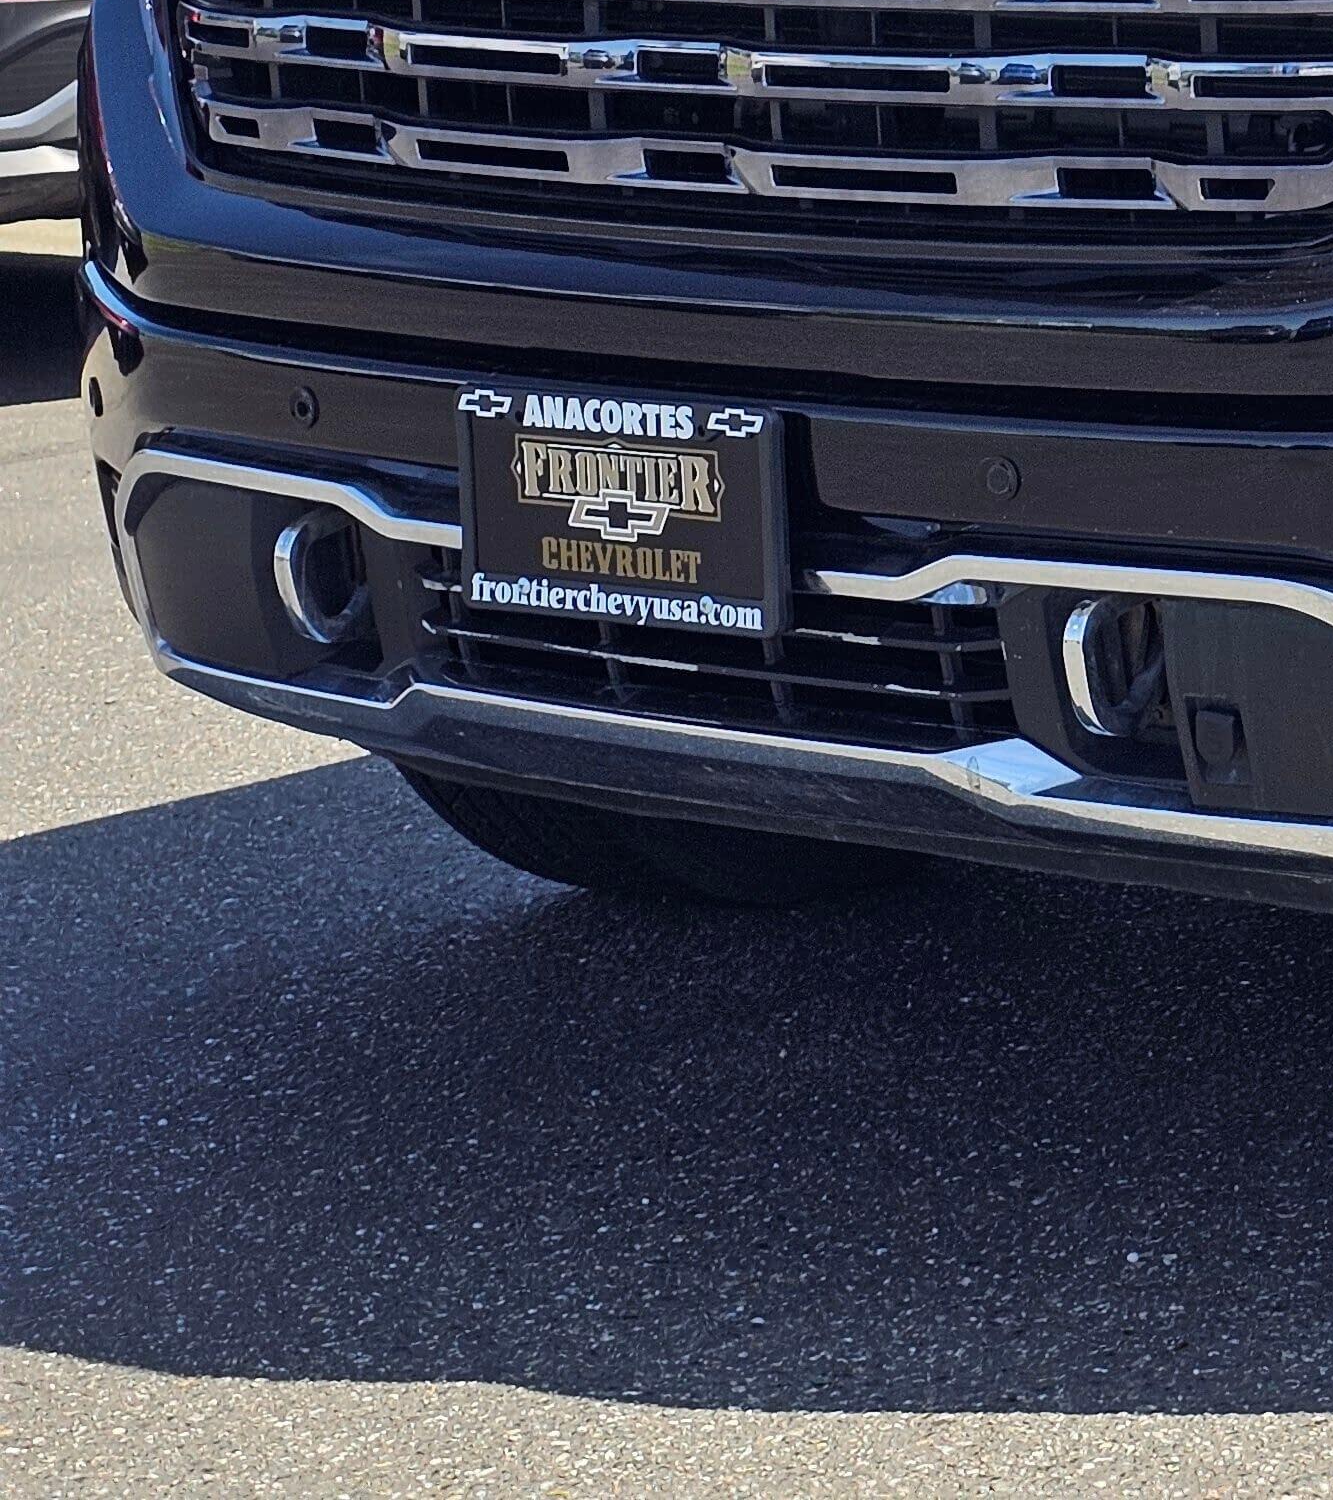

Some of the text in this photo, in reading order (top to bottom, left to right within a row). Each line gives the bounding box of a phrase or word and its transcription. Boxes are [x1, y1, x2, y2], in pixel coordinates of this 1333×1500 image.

[522, 394, 694, 440] ANACORTES
[520, 441, 716, 513] FRONTIER
[541, 536, 702, 584] CHEVROLET
[470, 572, 764, 631] frontierchevyusa.com
